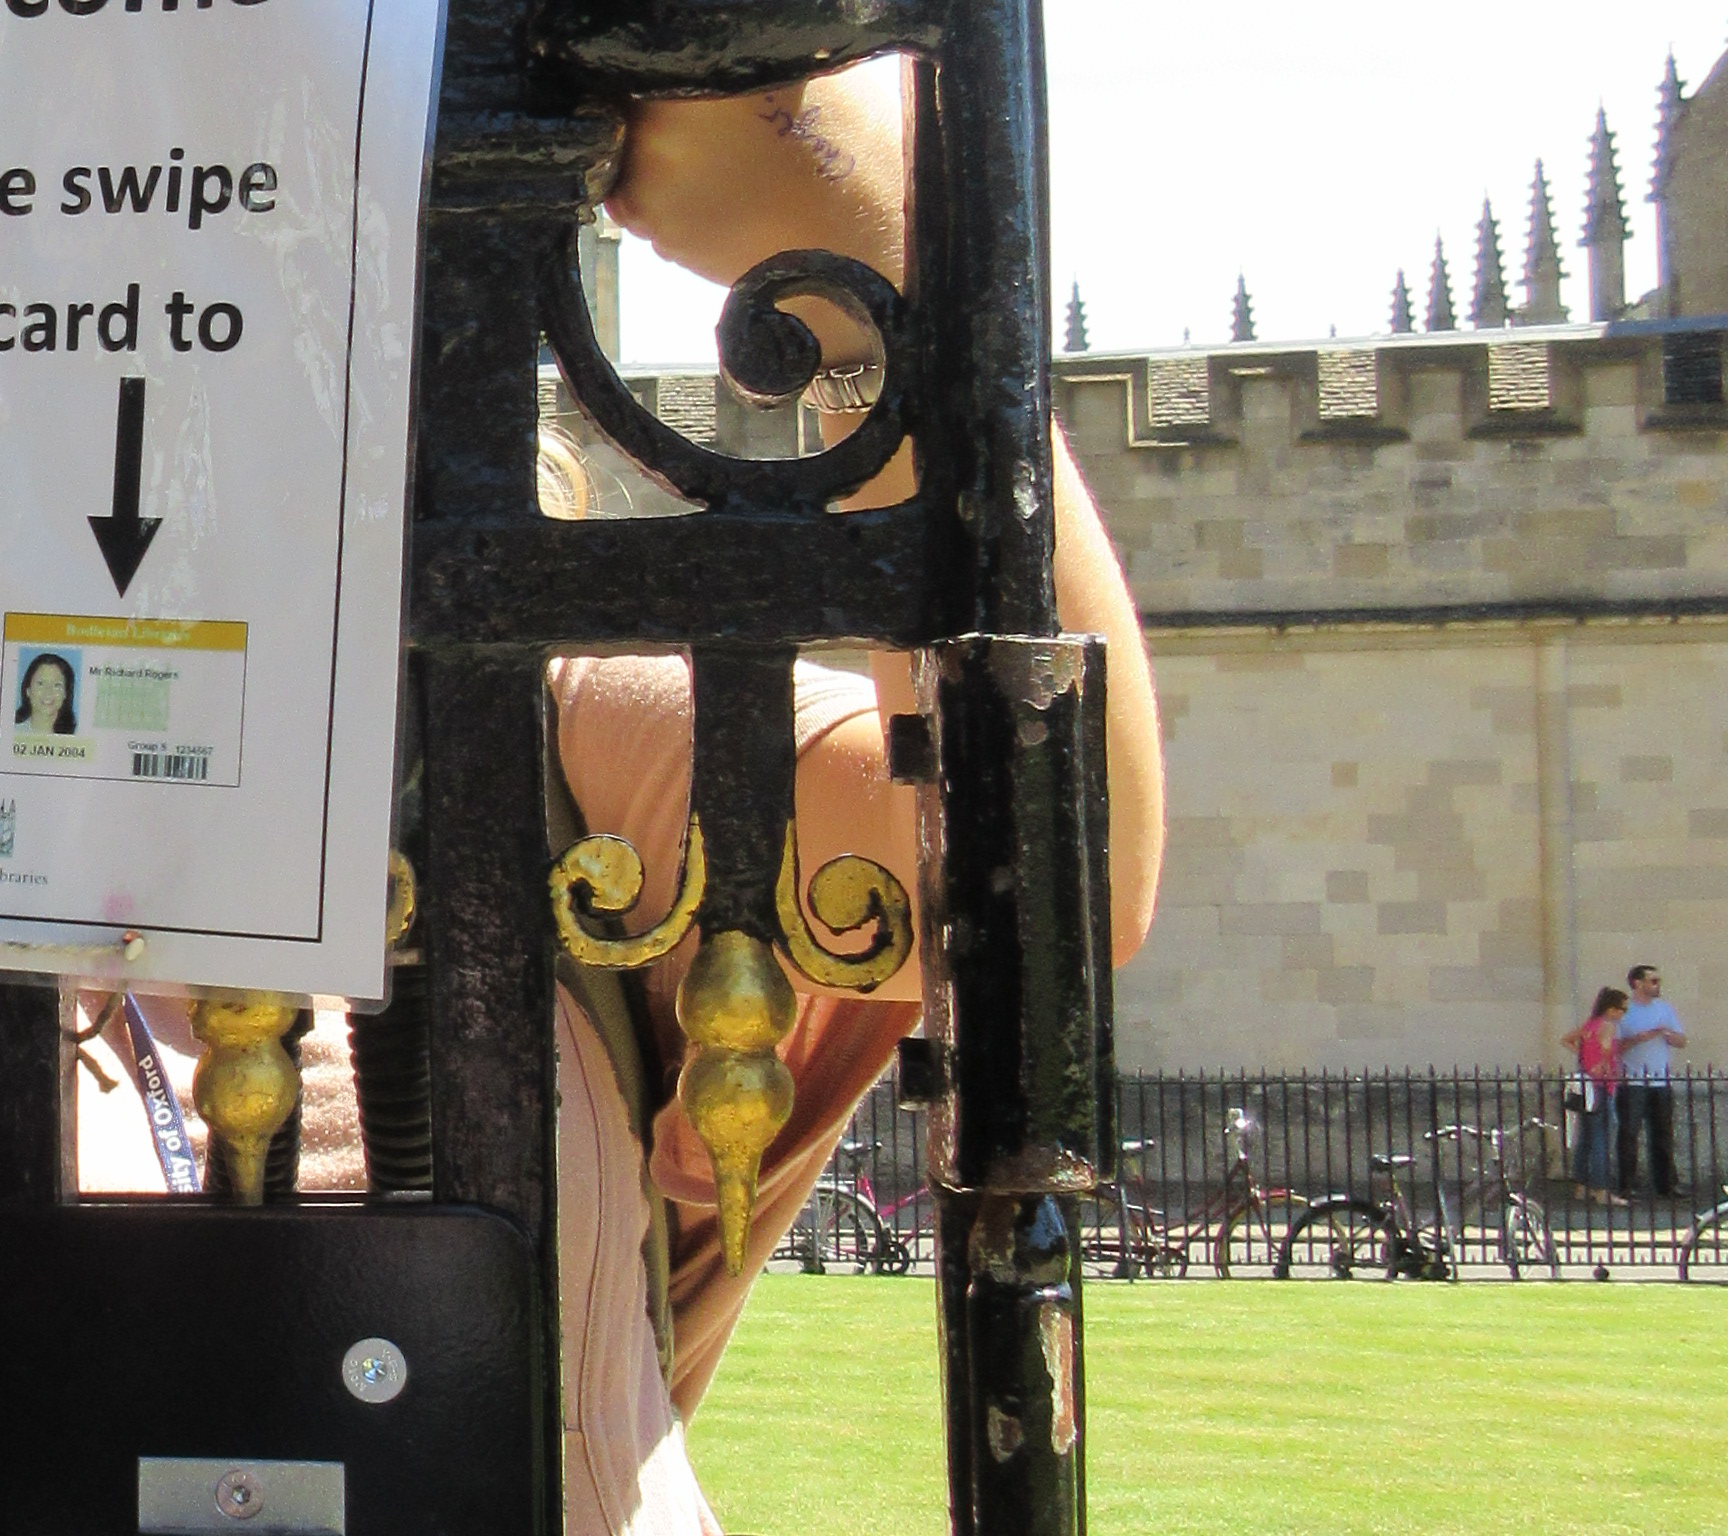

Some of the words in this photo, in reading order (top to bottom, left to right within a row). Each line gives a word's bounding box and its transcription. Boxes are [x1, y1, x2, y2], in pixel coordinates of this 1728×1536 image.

[60, 147, 278, 230] swipe
[164, 291, 243, 353] to
[89, 666, 102, 676] Mr
[104, 666, 143, 678] Richard
[12, 743, 27, 755] 02
[29, 744, 55, 757] JAN
[138, 1053, 174, 1127] Oxford
[158, 1128, 182, 1152] of
